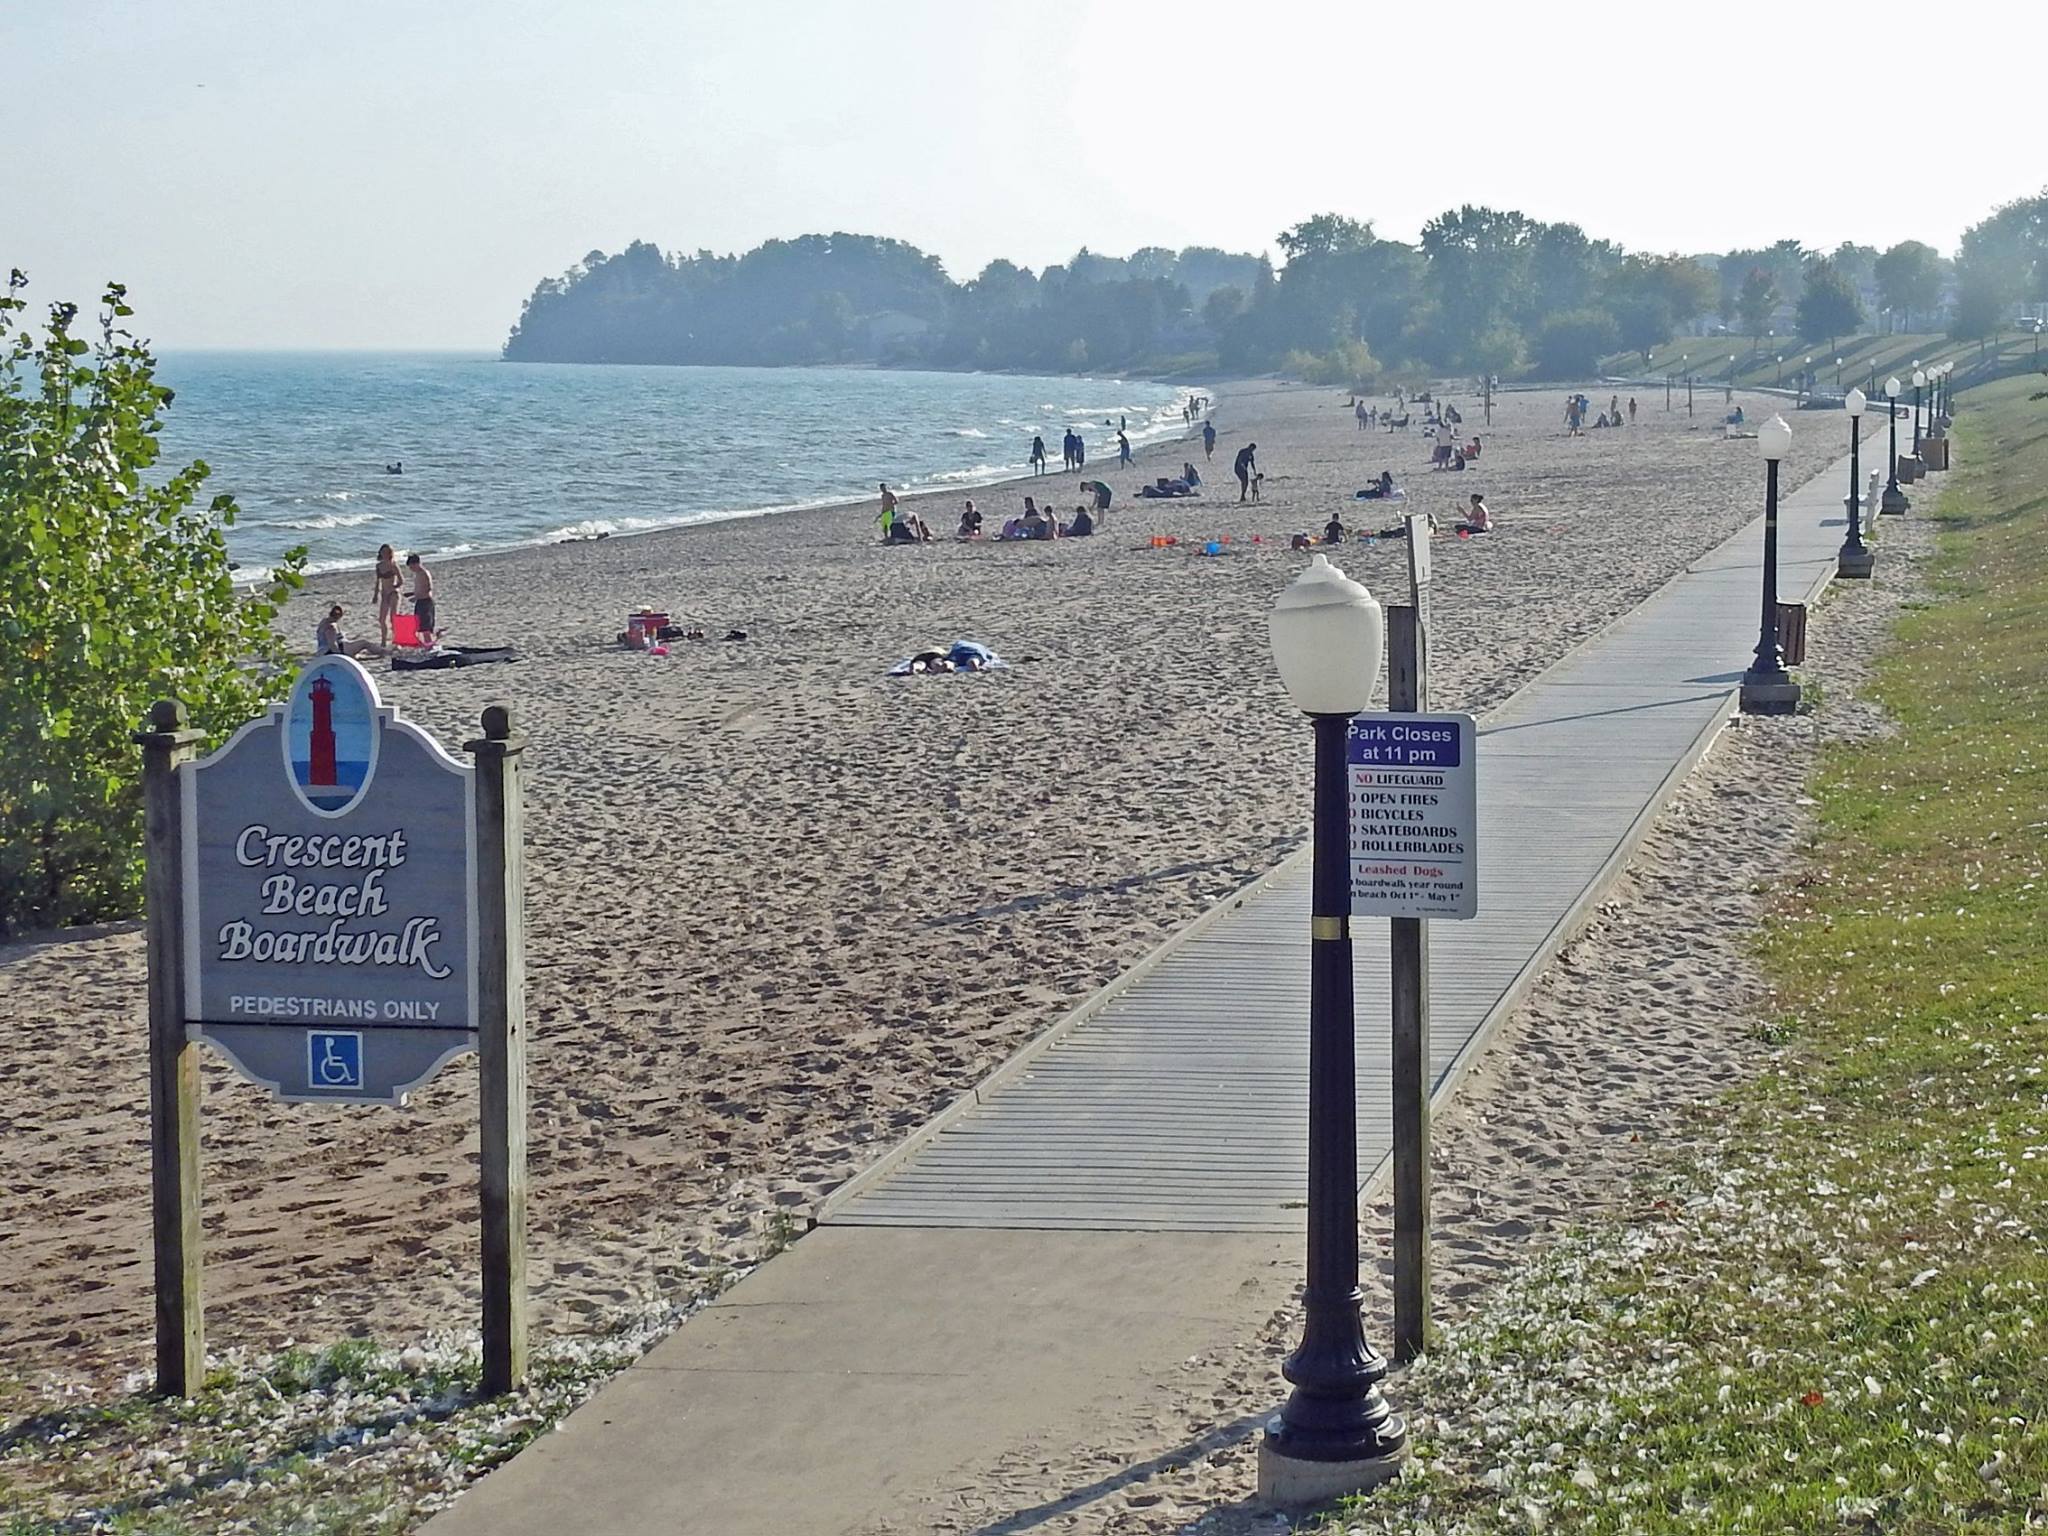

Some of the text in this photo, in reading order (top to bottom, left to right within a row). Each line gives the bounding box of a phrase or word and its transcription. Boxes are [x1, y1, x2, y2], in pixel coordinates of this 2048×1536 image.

[1348, 726, 1452, 742] Park Closes
[1363, 746, 1436, 763] at 11 pm
[1355, 774, 1443, 786] NO LIFEGUARD
[1361, 793, 1396, 804] OPEN
[1401, 794, 1438, 805] FIRES
[1361, 809, 1424, 821] BICYCLES
[1361, 825, 1457, 838] SKATEBOARDS
[235, 824, 408, 868] Crescent
[1362, 840, 1464, 854] ROLLERBLADES
[1359, 864, 1443, 877] Leashed Dogs
[1356, 878, 1406, 888] boardwalk
[1434, 881, 1463, 890] round
[260, 867, 388, 917] Beach
[1358, 890, 1387, 899] beach
[1390, 891, 1406, 900] Oct
[1427, 892, 1446, 902] May
[218, 917, 452, 979] Boardwalk
[230, 995, 441, 1020] PEDESTRIANS ONLY
